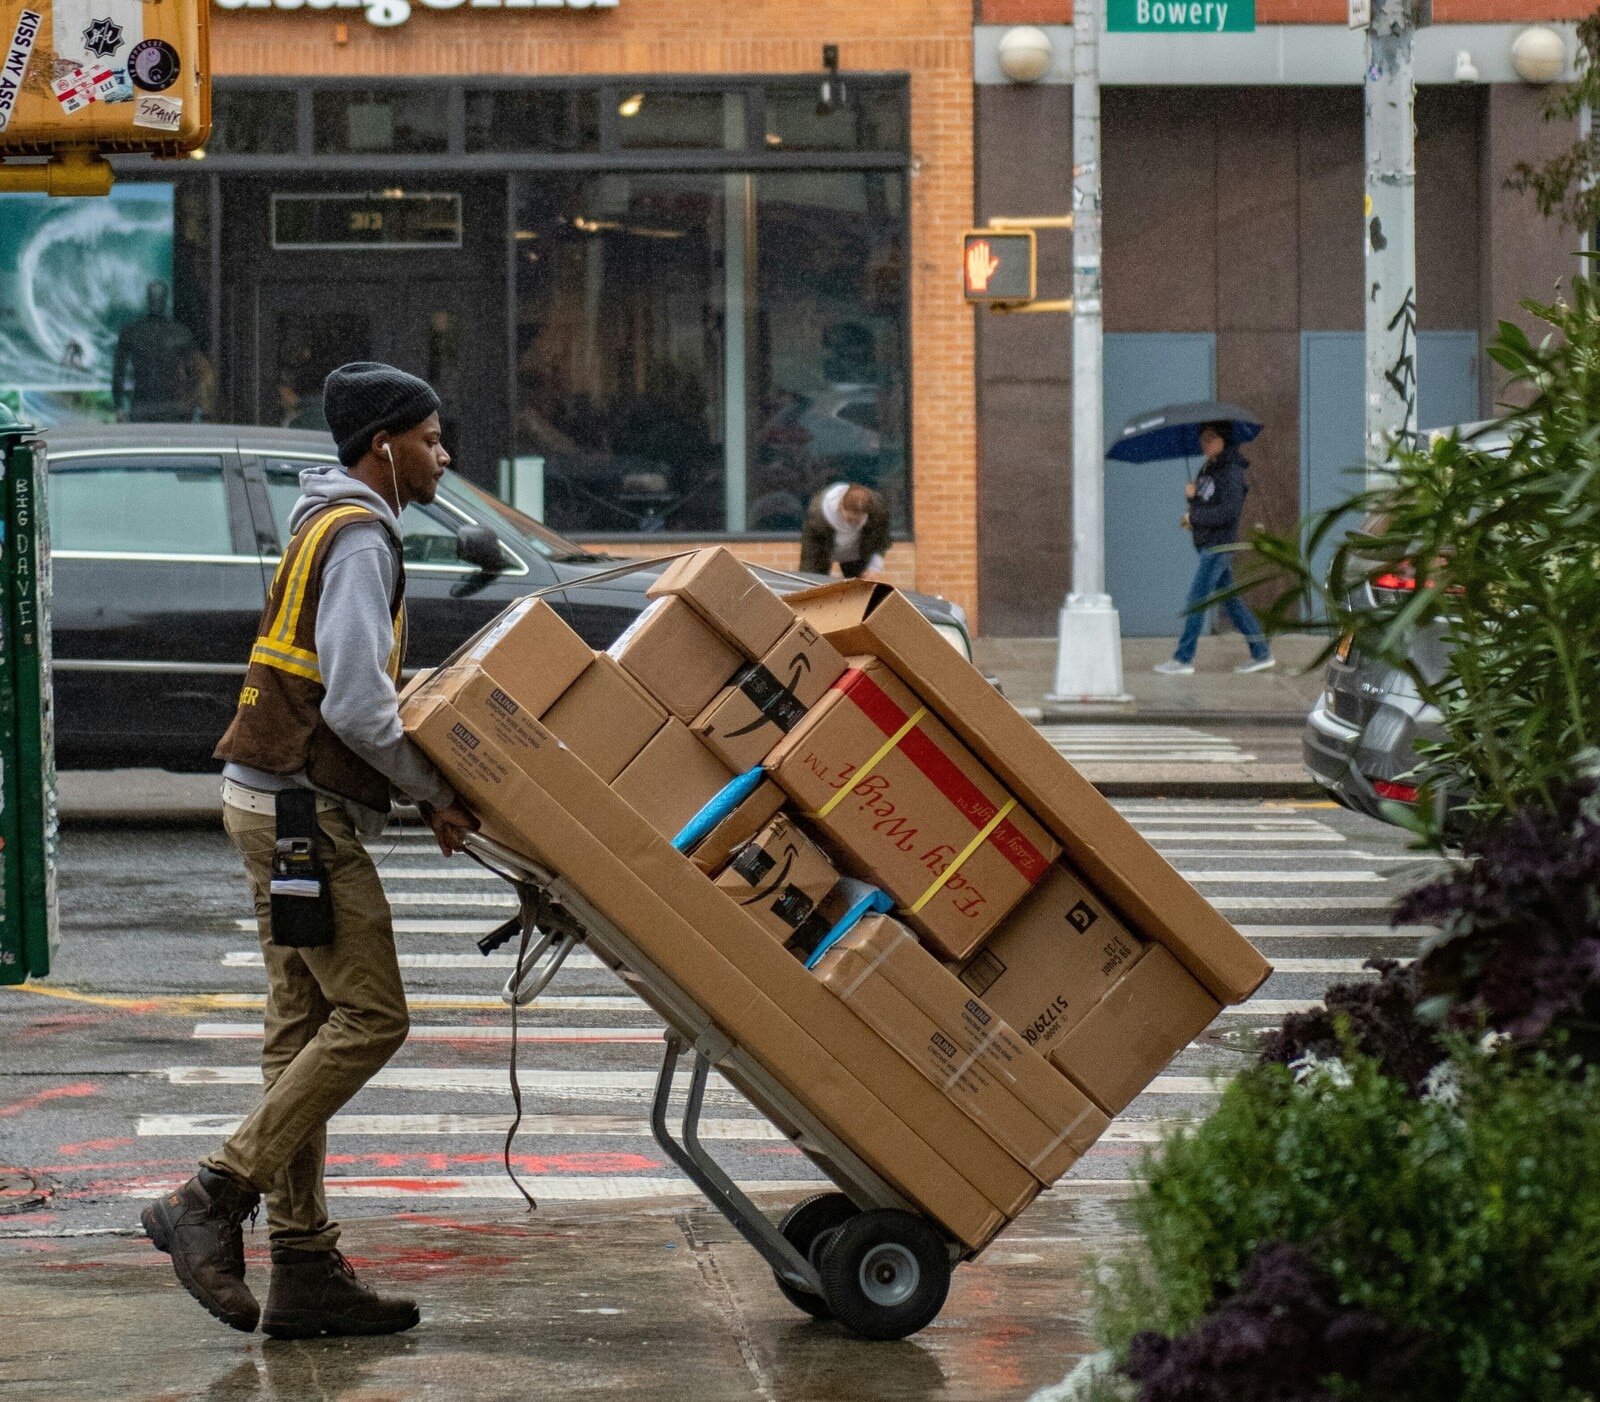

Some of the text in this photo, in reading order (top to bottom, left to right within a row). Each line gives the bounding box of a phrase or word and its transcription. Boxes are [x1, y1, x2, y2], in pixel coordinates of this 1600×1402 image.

[1137, 0, 1228, 31] Bowery
[0, 11, 40, 110] KISS MY ASS
[16, 478, 33, 626] BIG DAVE
[490, 688, 518, 714] ULINE
[445, 732, 468, 752] CHROME
[466, 751, 479, 763] WIRE
[452, 722, 480, 749] ULINE
[829, 762, 921, 852] Weigh
[968, 803, 1006, 840] Wigh
[1006, 836, 1035, 869] Easy
[919, 845, 987, 918] Easy
[964, 999, 991, 1024] ULINE
[931, 1032, 956, 1057] ULINE
